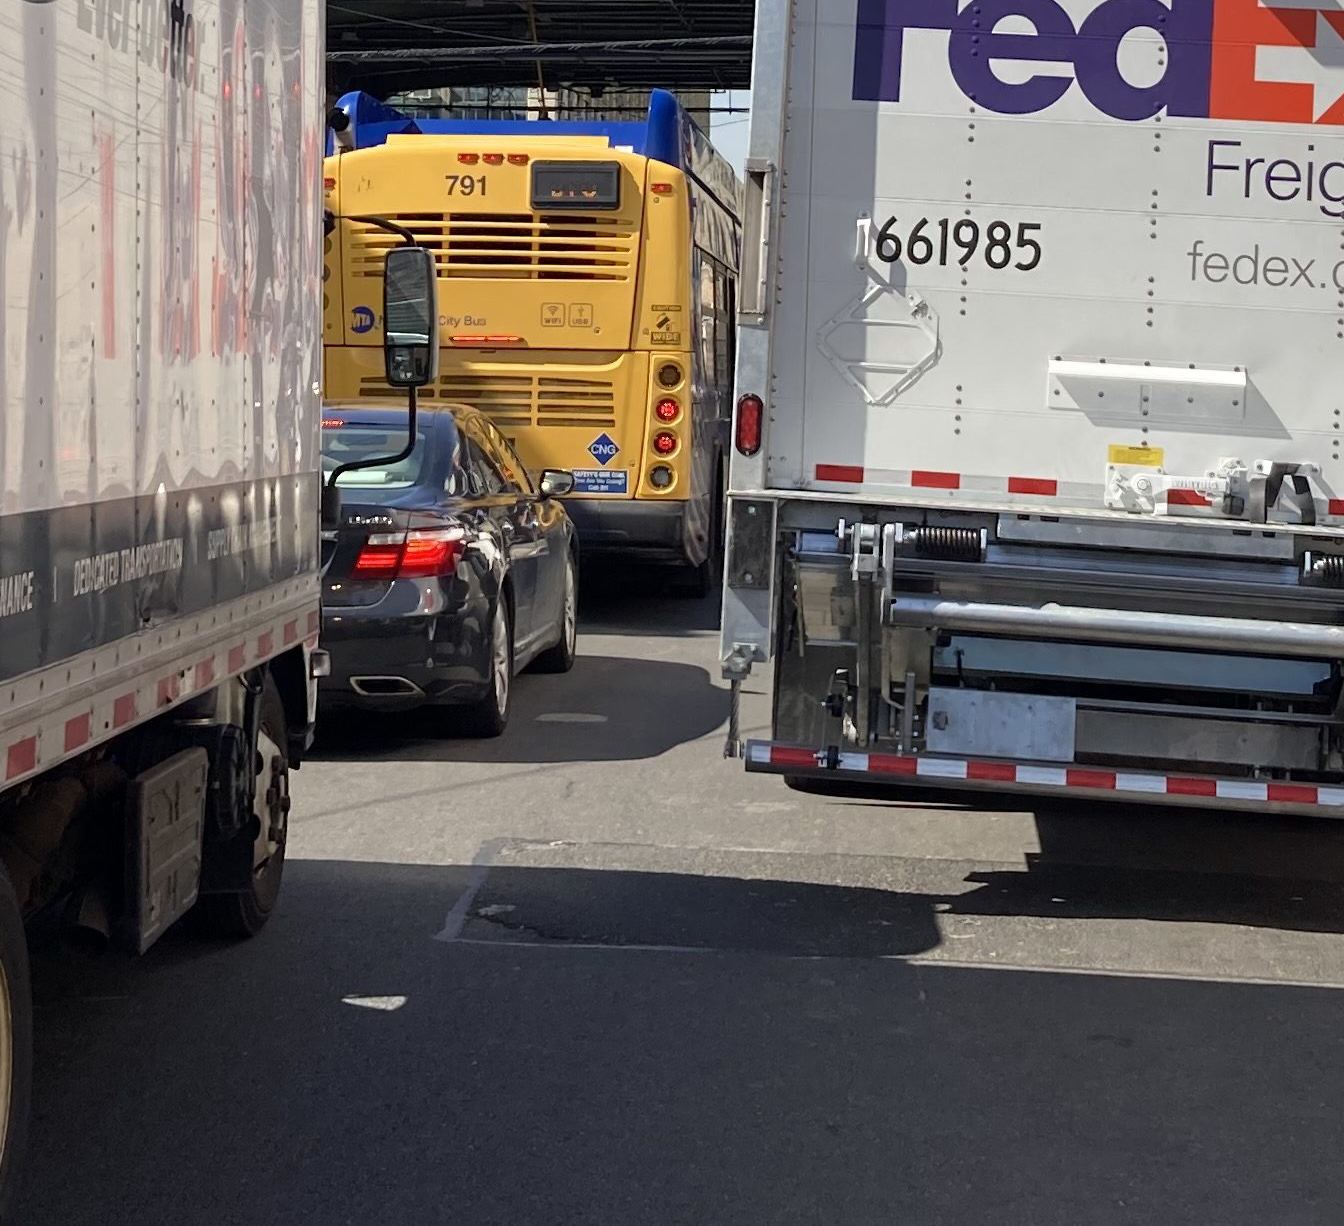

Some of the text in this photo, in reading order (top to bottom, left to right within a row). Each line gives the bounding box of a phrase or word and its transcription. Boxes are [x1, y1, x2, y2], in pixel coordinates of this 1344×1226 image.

[445, 175, 487, 196] 791
[875, 215, 1042, 272] 661985
[438, 315, 487, 327] City Bus
[590, 444, 616, 455] CNG
[73, 551, 119, 597] DEDICATED
